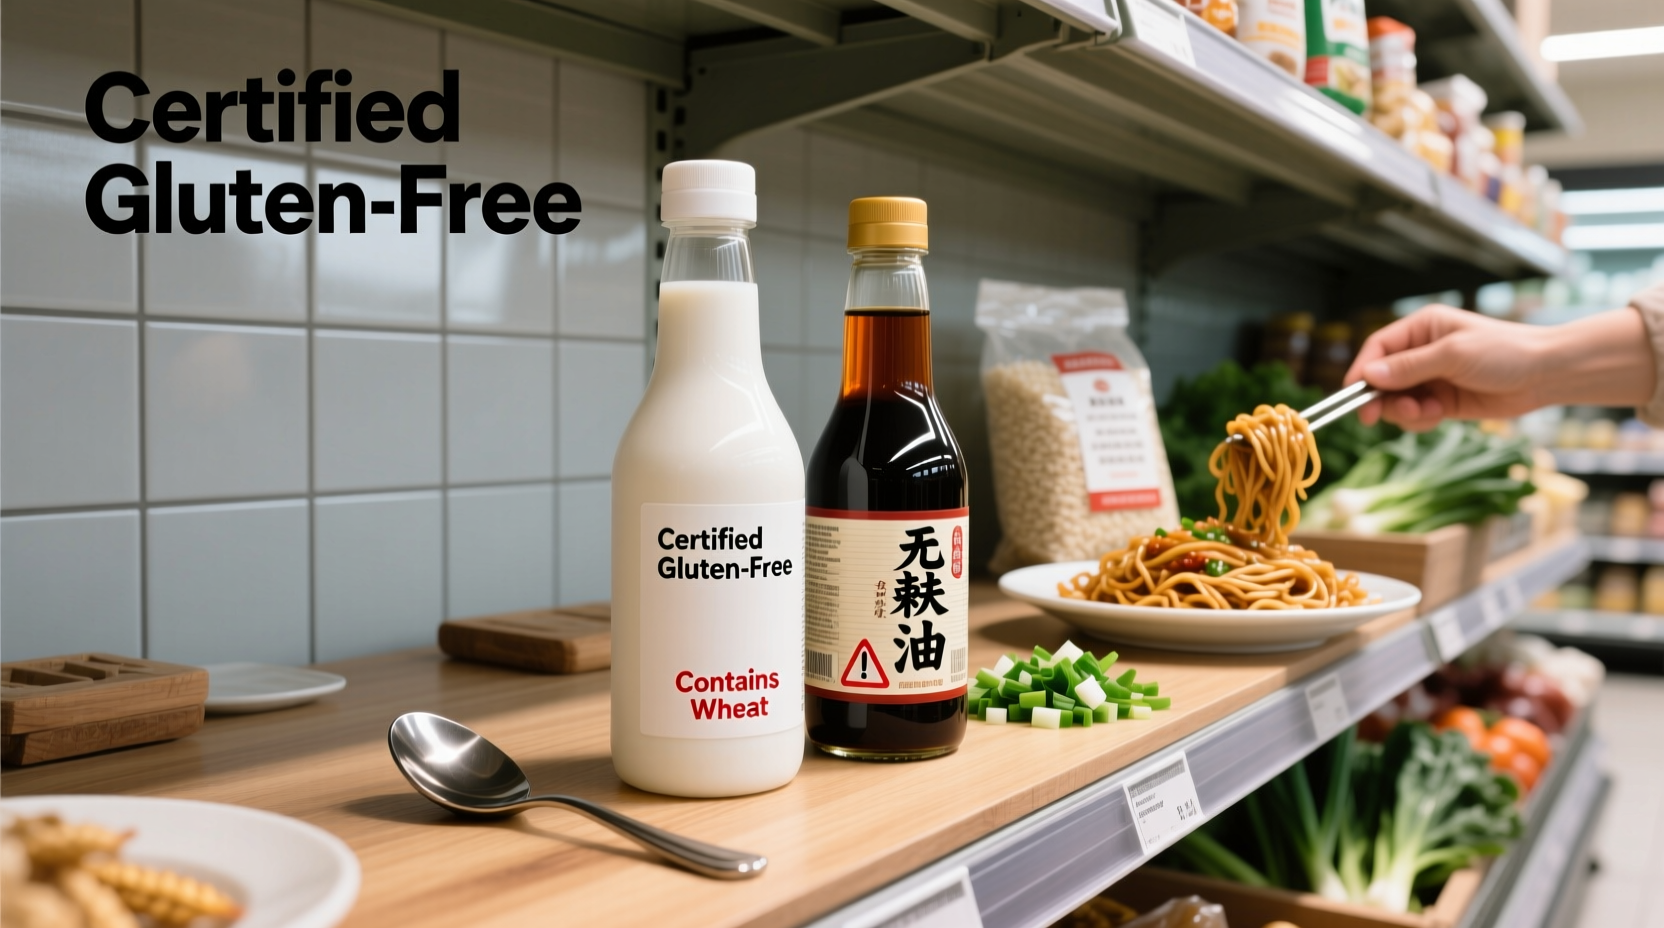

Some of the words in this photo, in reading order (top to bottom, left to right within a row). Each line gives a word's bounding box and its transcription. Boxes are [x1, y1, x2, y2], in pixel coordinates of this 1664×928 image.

[657, 526, 763, 550] Certified
[657, 556, 793, 579] Gluten-Free
[675, 668, 780, 693] Contains
[690, 697, 769, 720] Wheat
